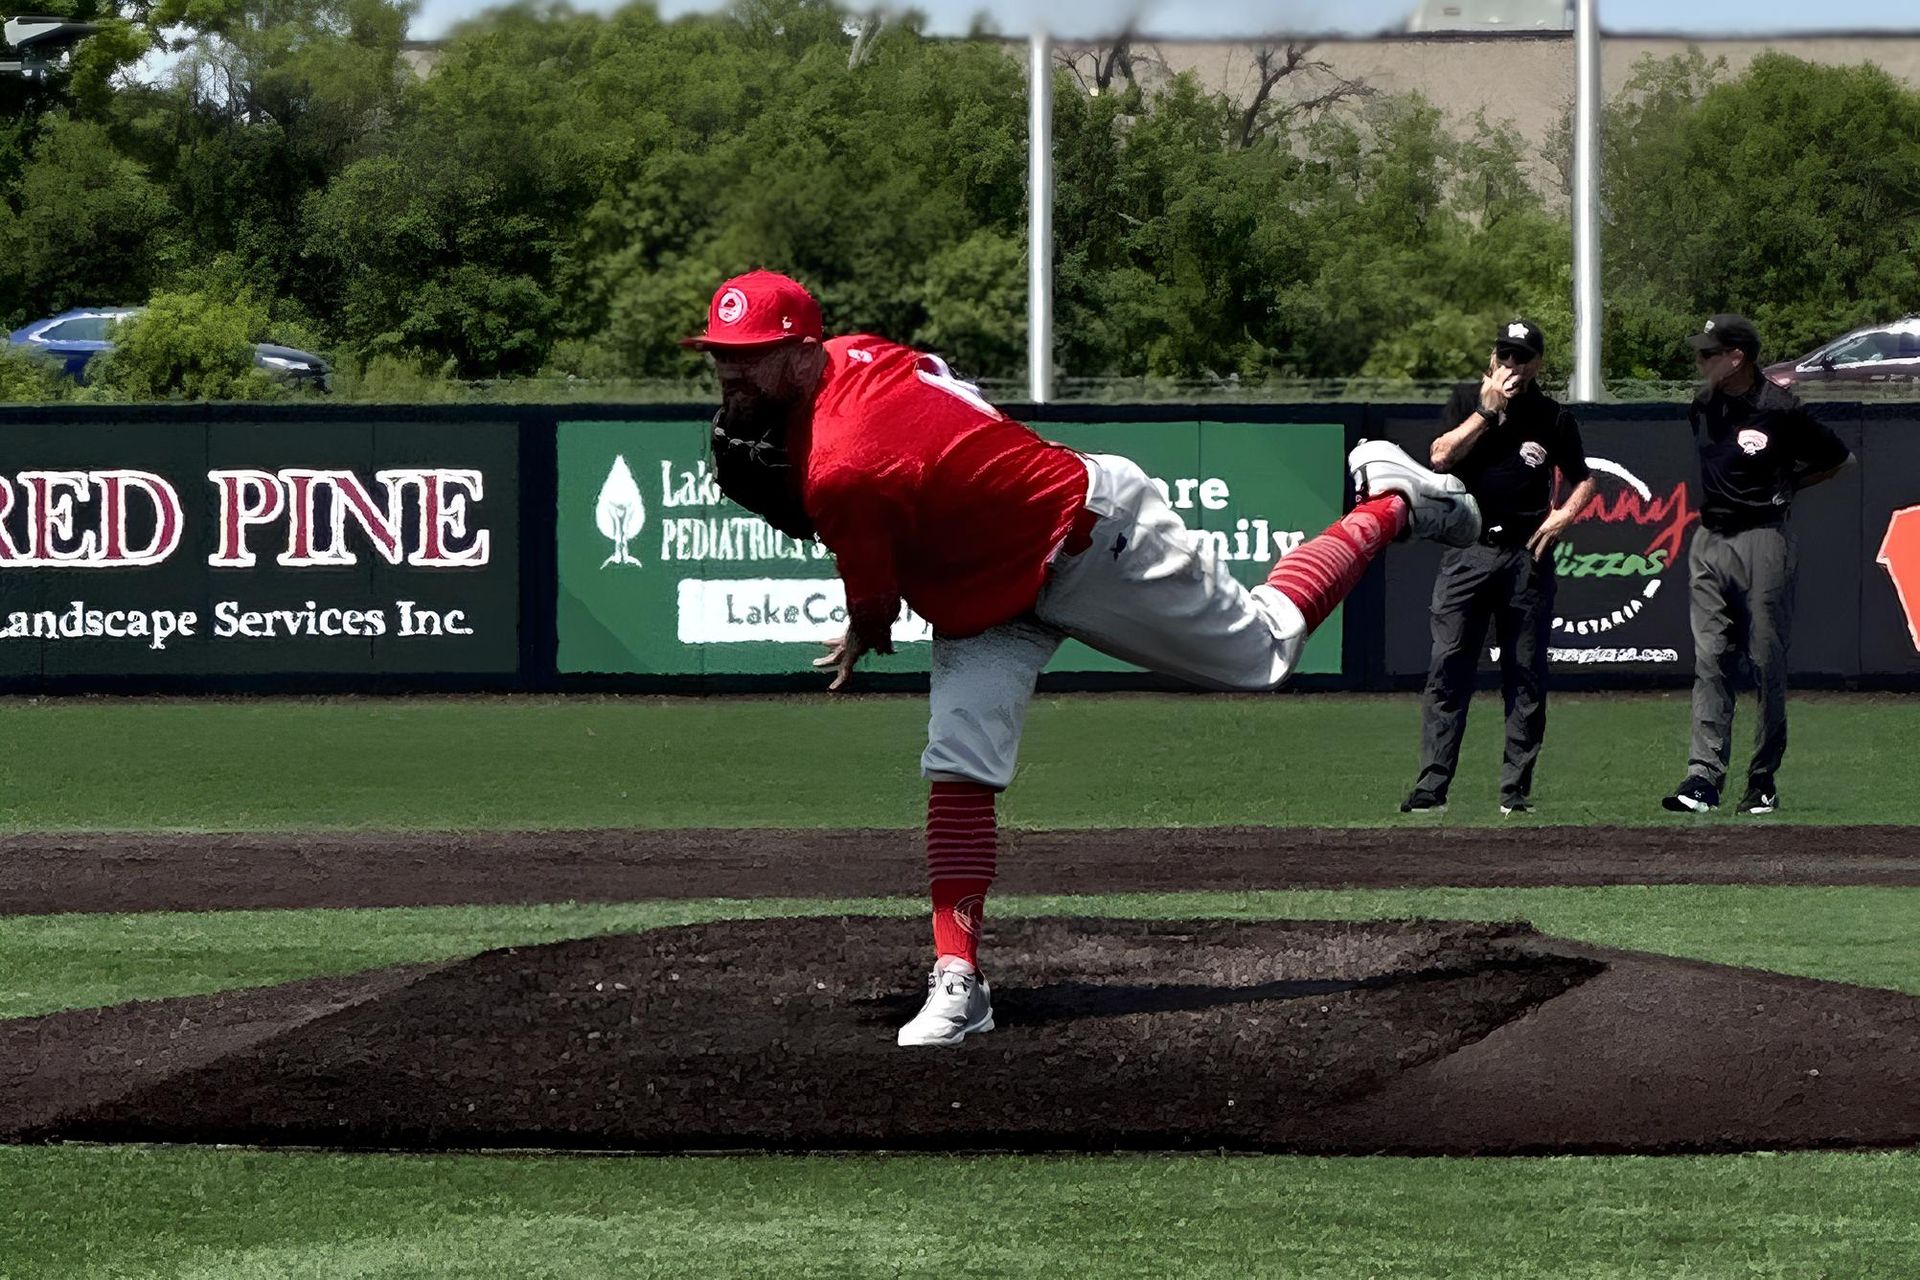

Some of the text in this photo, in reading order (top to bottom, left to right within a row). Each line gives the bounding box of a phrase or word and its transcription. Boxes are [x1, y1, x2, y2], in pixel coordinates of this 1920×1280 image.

[208, 469, 489, 567] PINE
[1186, 518, 1305, 562] mily
[0, 601, 197, 649] andscape
[214, 601, 387, 637] Services
